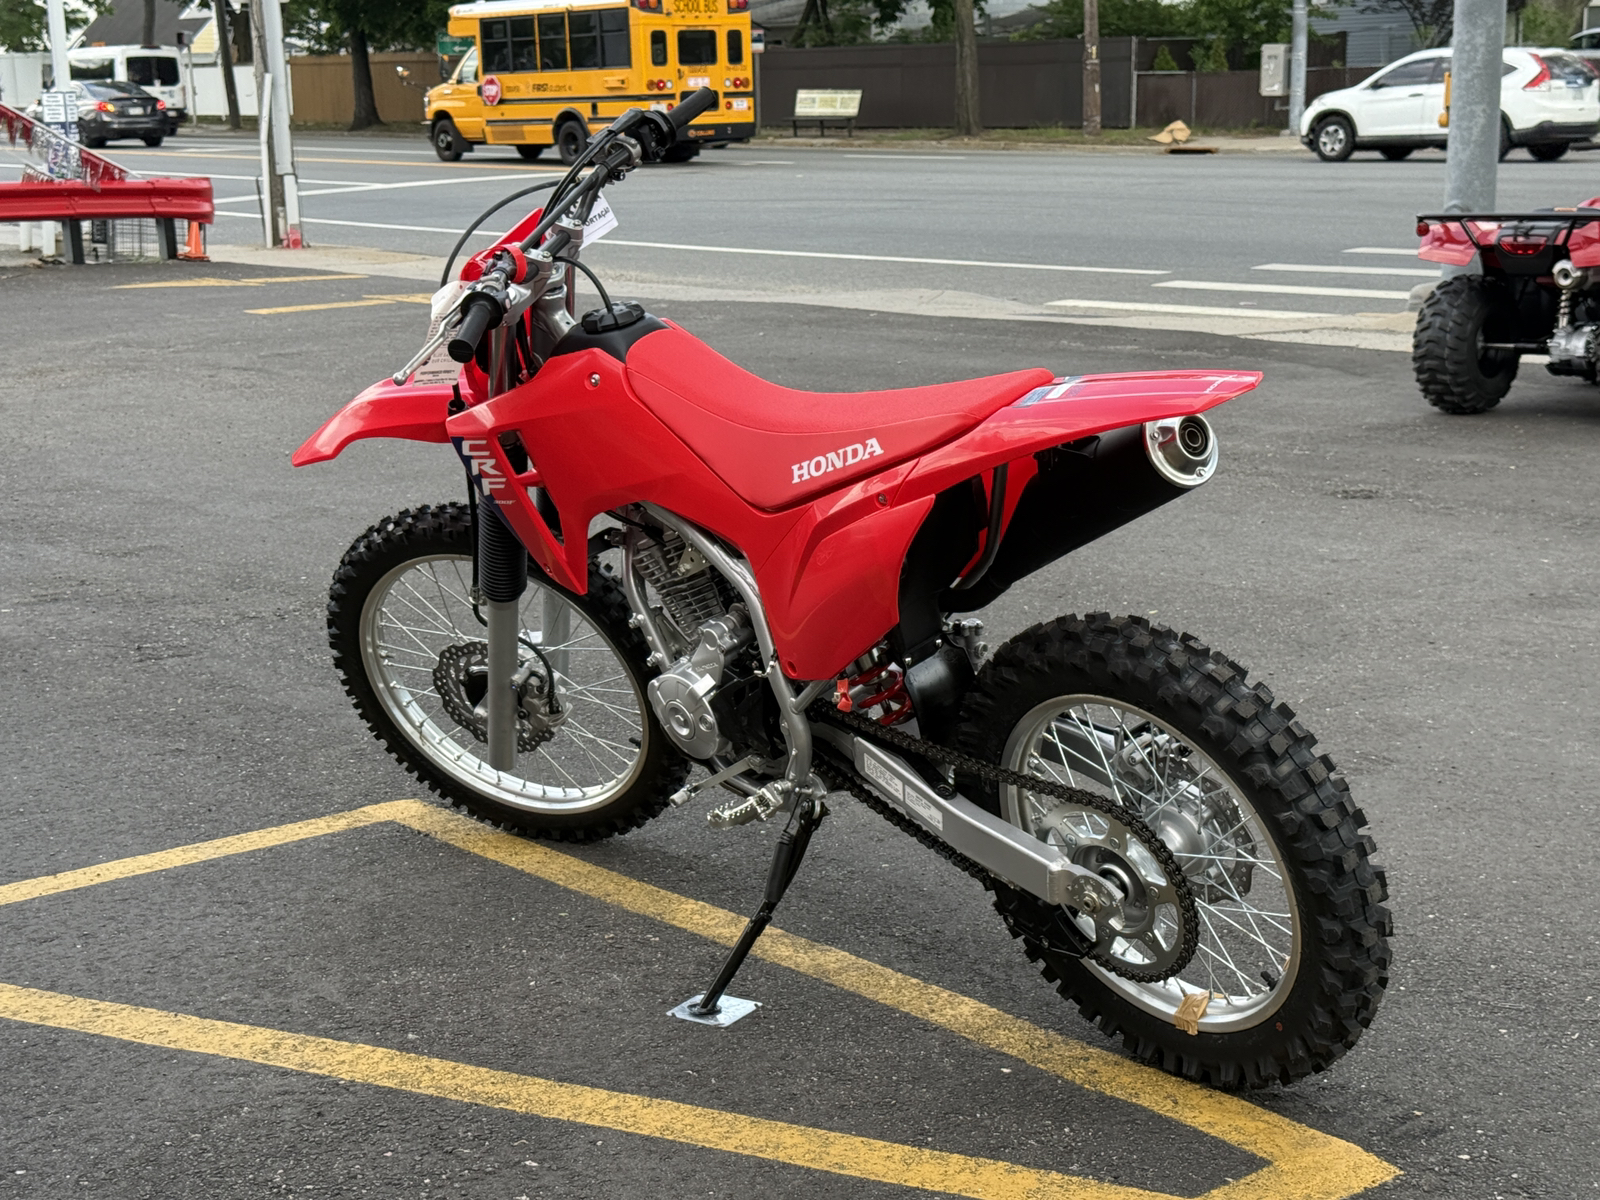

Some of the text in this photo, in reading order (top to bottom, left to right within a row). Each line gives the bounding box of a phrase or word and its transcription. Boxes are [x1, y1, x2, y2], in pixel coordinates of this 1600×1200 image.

[673, 0, 719, 13] SCHOOL BUS
[462, 440, 508, 496] CRF
[791, 437, 885, 485] HONDA
